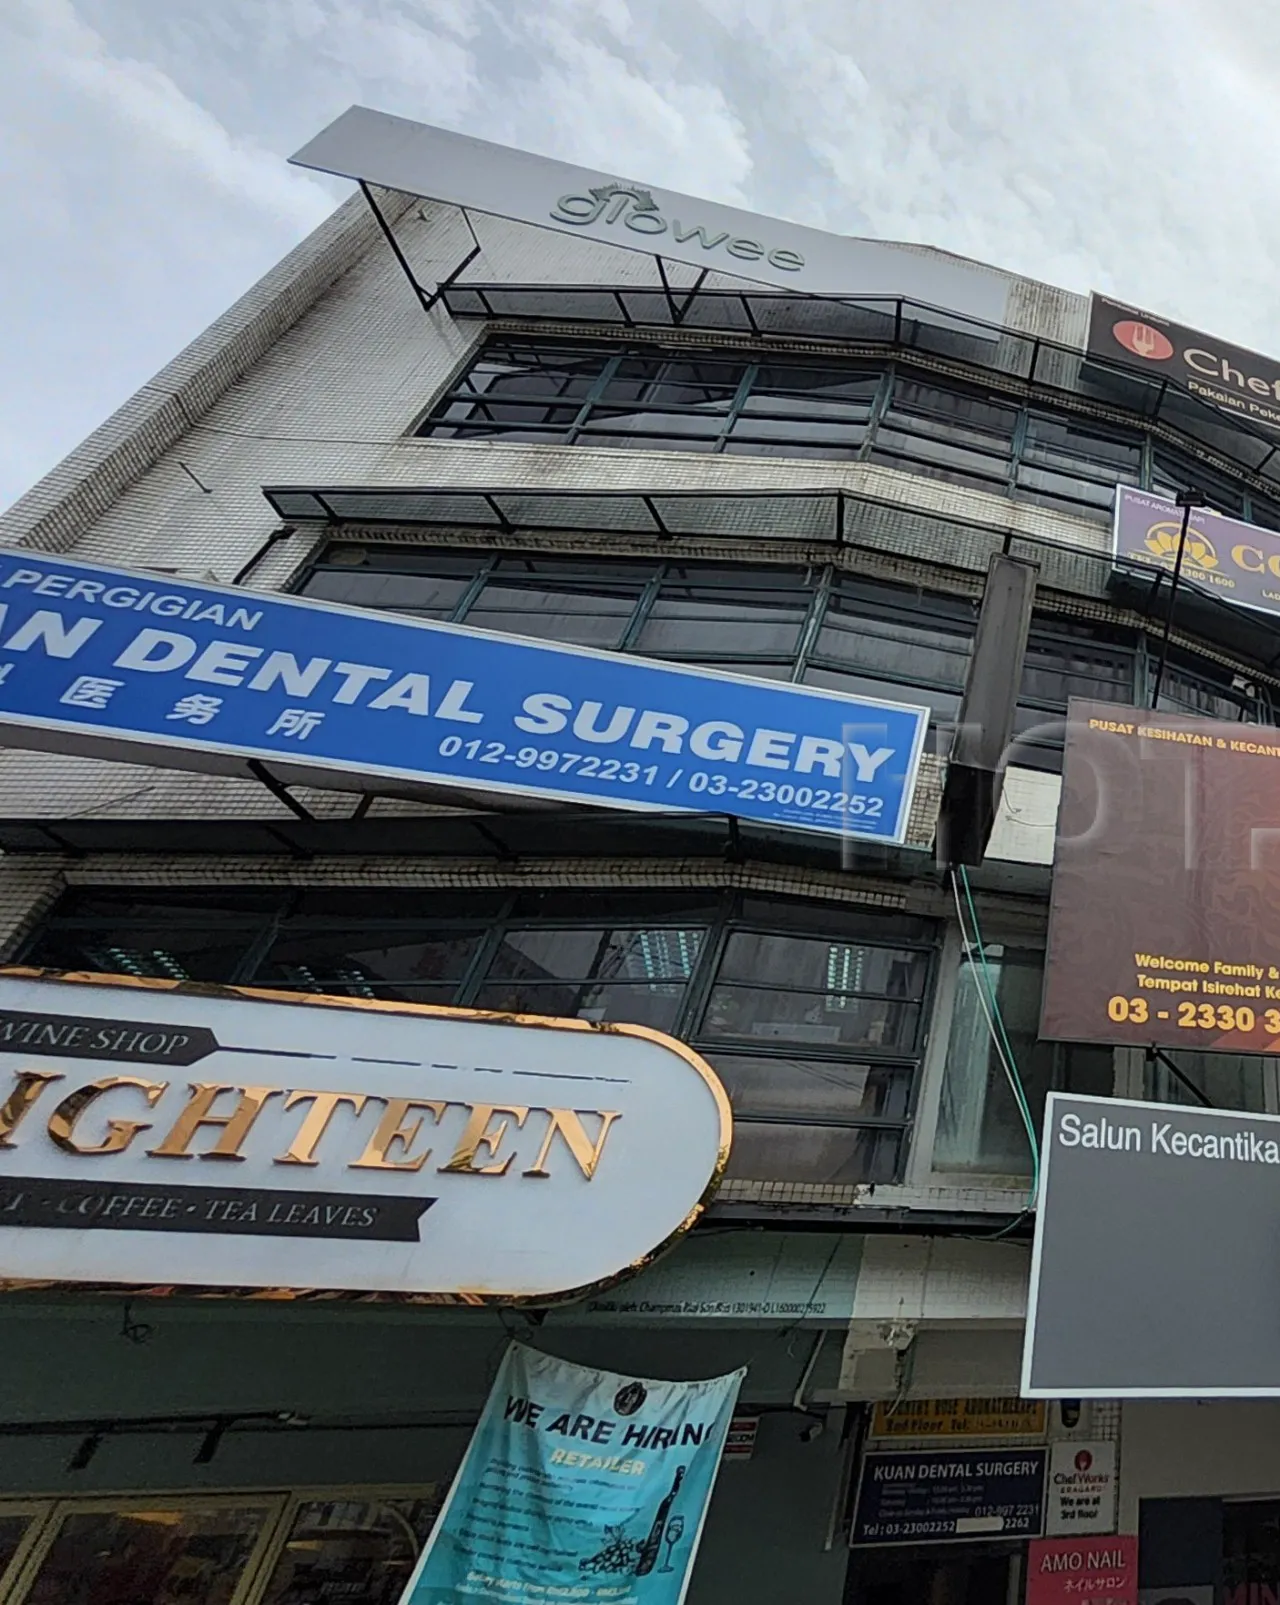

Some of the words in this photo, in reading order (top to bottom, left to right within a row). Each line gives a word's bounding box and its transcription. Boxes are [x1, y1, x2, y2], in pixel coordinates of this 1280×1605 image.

[1187, 381, 1246, 410] Pakaian
[1, 569, 263, 631] PERGIGIAN
[112, 628, 484, 724] DENTAL
[514, 692, 895, 783] SURGERY
[1088, 718, 1134, 736] PUSAT
[1137, 725, 1213, 749] KESIHATAN
[1216, 737, 1227, 750] &
[438, 735, 658, 787] 012-9972231
[666, 770, 681, 789] /
[688, 771, 884, 818] 03-23002252
[1134, 953, 1210, 974] Welcome
[1214, 961, 1264, 981] Family
[1268, 967, 1280, 980] &
[1137, 974, 1198, 993] Tempat
[1108, 996, 1149, 1024] 03
[1177, 1002, 1255, 1032] 2330
[90, 1028, 190, 1055] SHOP
[1058, 1113, 1142, 1153] Salun
[205, 1200, 259, 1222] TEA
[265, 1203, 378, 1227] LEAVES
[503, 1394, 545, 1429] WE
[545, 1413, 616, 1446] ARE
[549, 1449, 647, 1476] RETAILER
[873, 1464, 916, 1481] KUAN
[918, 1463, 973, 1479] DENTAL
[975, 1461, 1040, 1477] SURGERY
[885, 1520, 956, 1536] 03-23002252
[1040, 1552, 1083, 1573] AMO
[1087, 1549, 1127, 1570] NAIL
[1063, 1577, 1126, 1593] ネイルサロン
